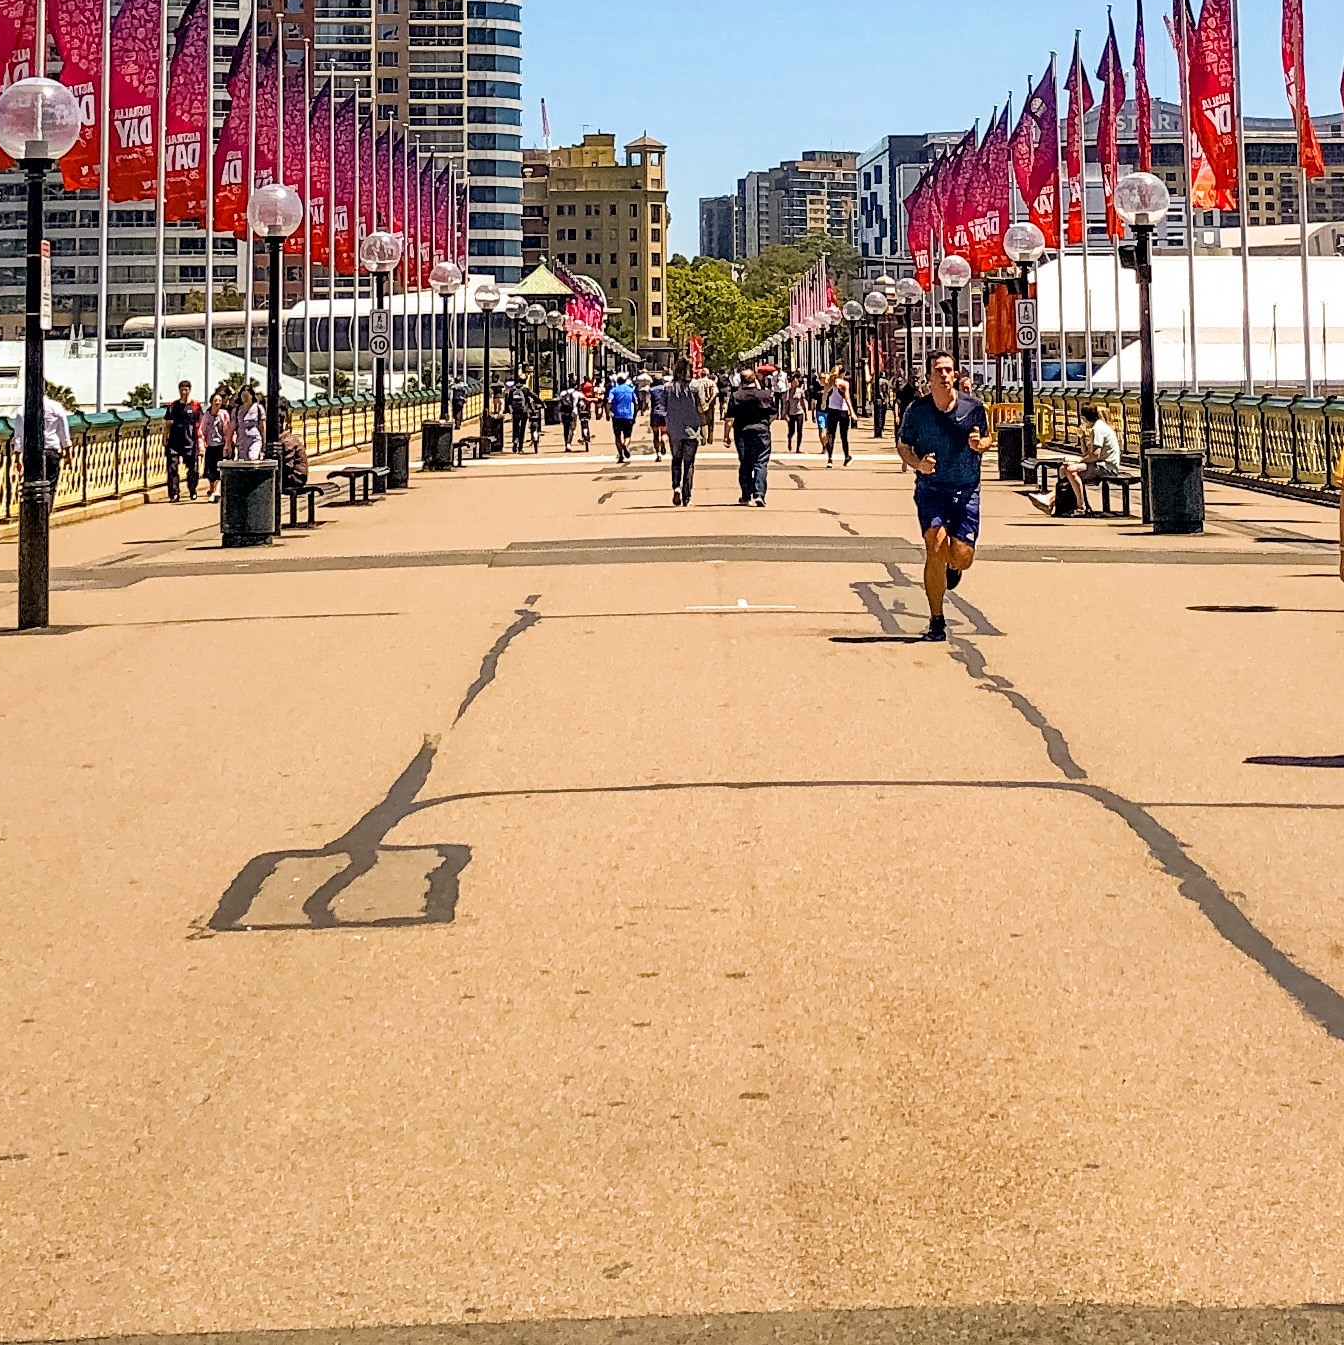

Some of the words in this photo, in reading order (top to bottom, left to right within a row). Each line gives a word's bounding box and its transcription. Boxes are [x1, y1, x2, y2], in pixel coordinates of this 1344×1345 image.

[1116, 114, 1171, 131] STR
[1020, 331, 1033, 341] 10
[373, 340, 385, 350] 10
